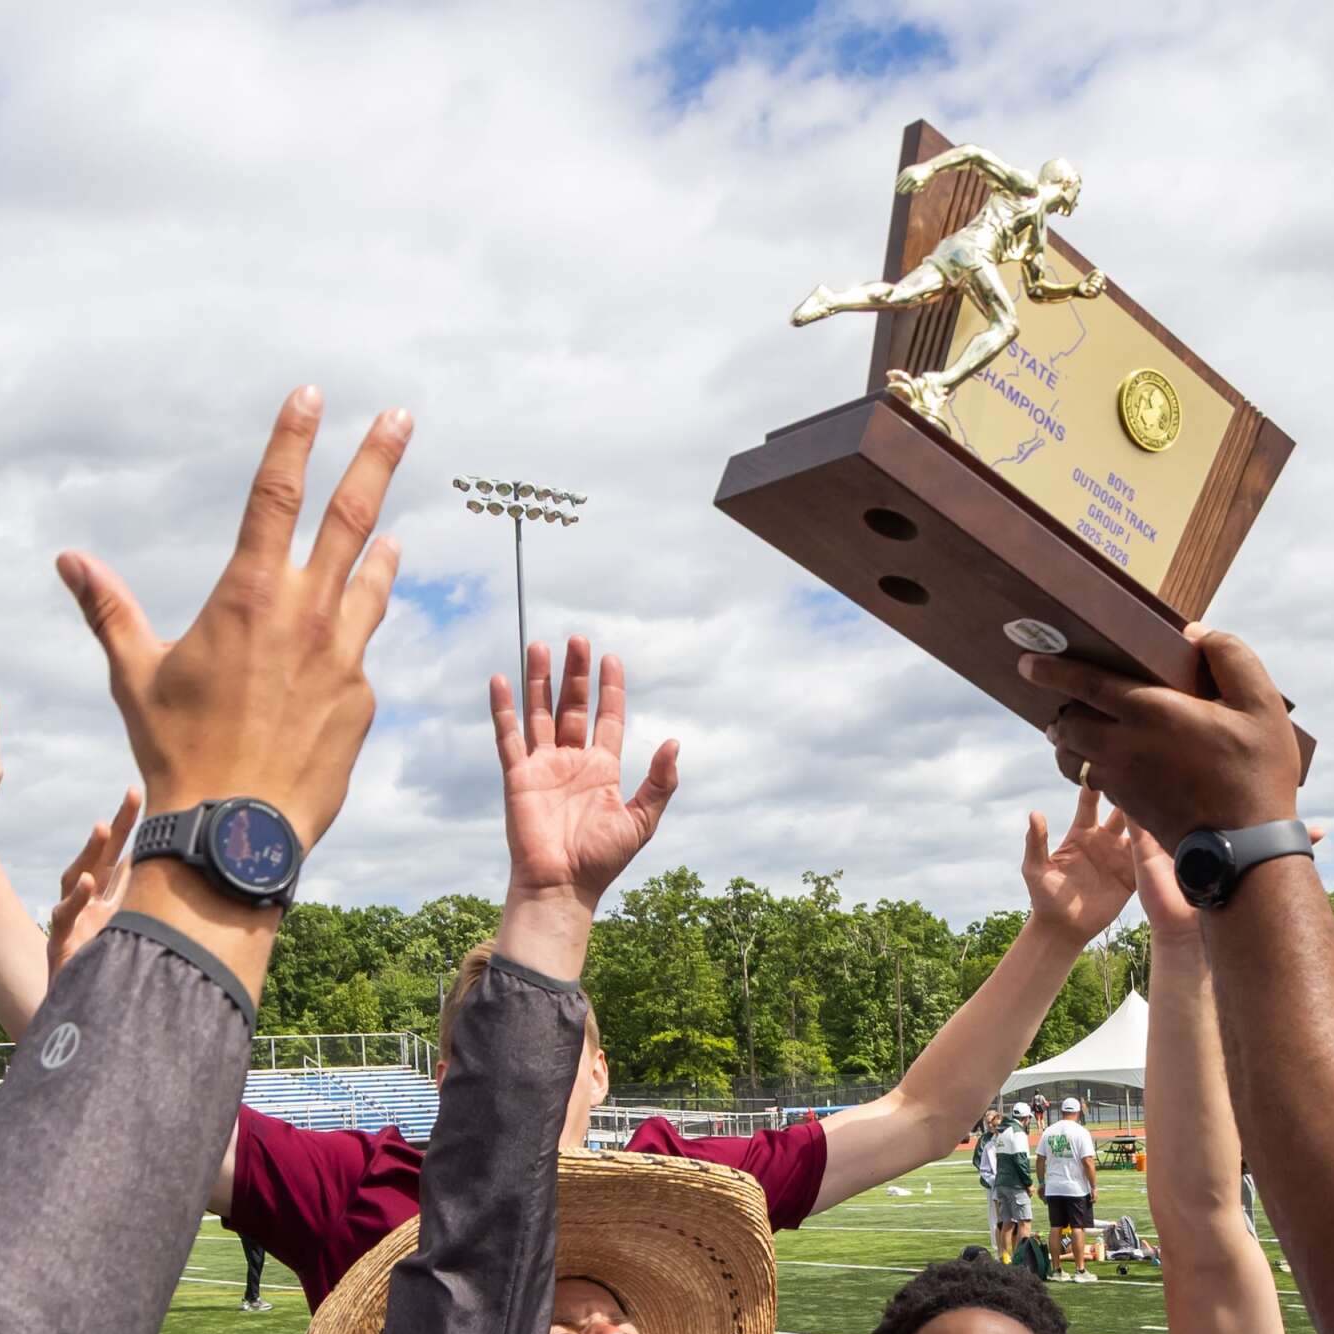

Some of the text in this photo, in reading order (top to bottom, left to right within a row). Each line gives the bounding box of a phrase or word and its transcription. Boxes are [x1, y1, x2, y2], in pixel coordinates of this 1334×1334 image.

[1007, 341, 1059, 391] STATE
[1073, 467, 1158, 543] OUTDOOR TRACK
[1107, 472, 1136, 502] BOYS
[1076, 518, 1130, 567] 2025-2026
[1087, 504, 1124, 537] GROUP
